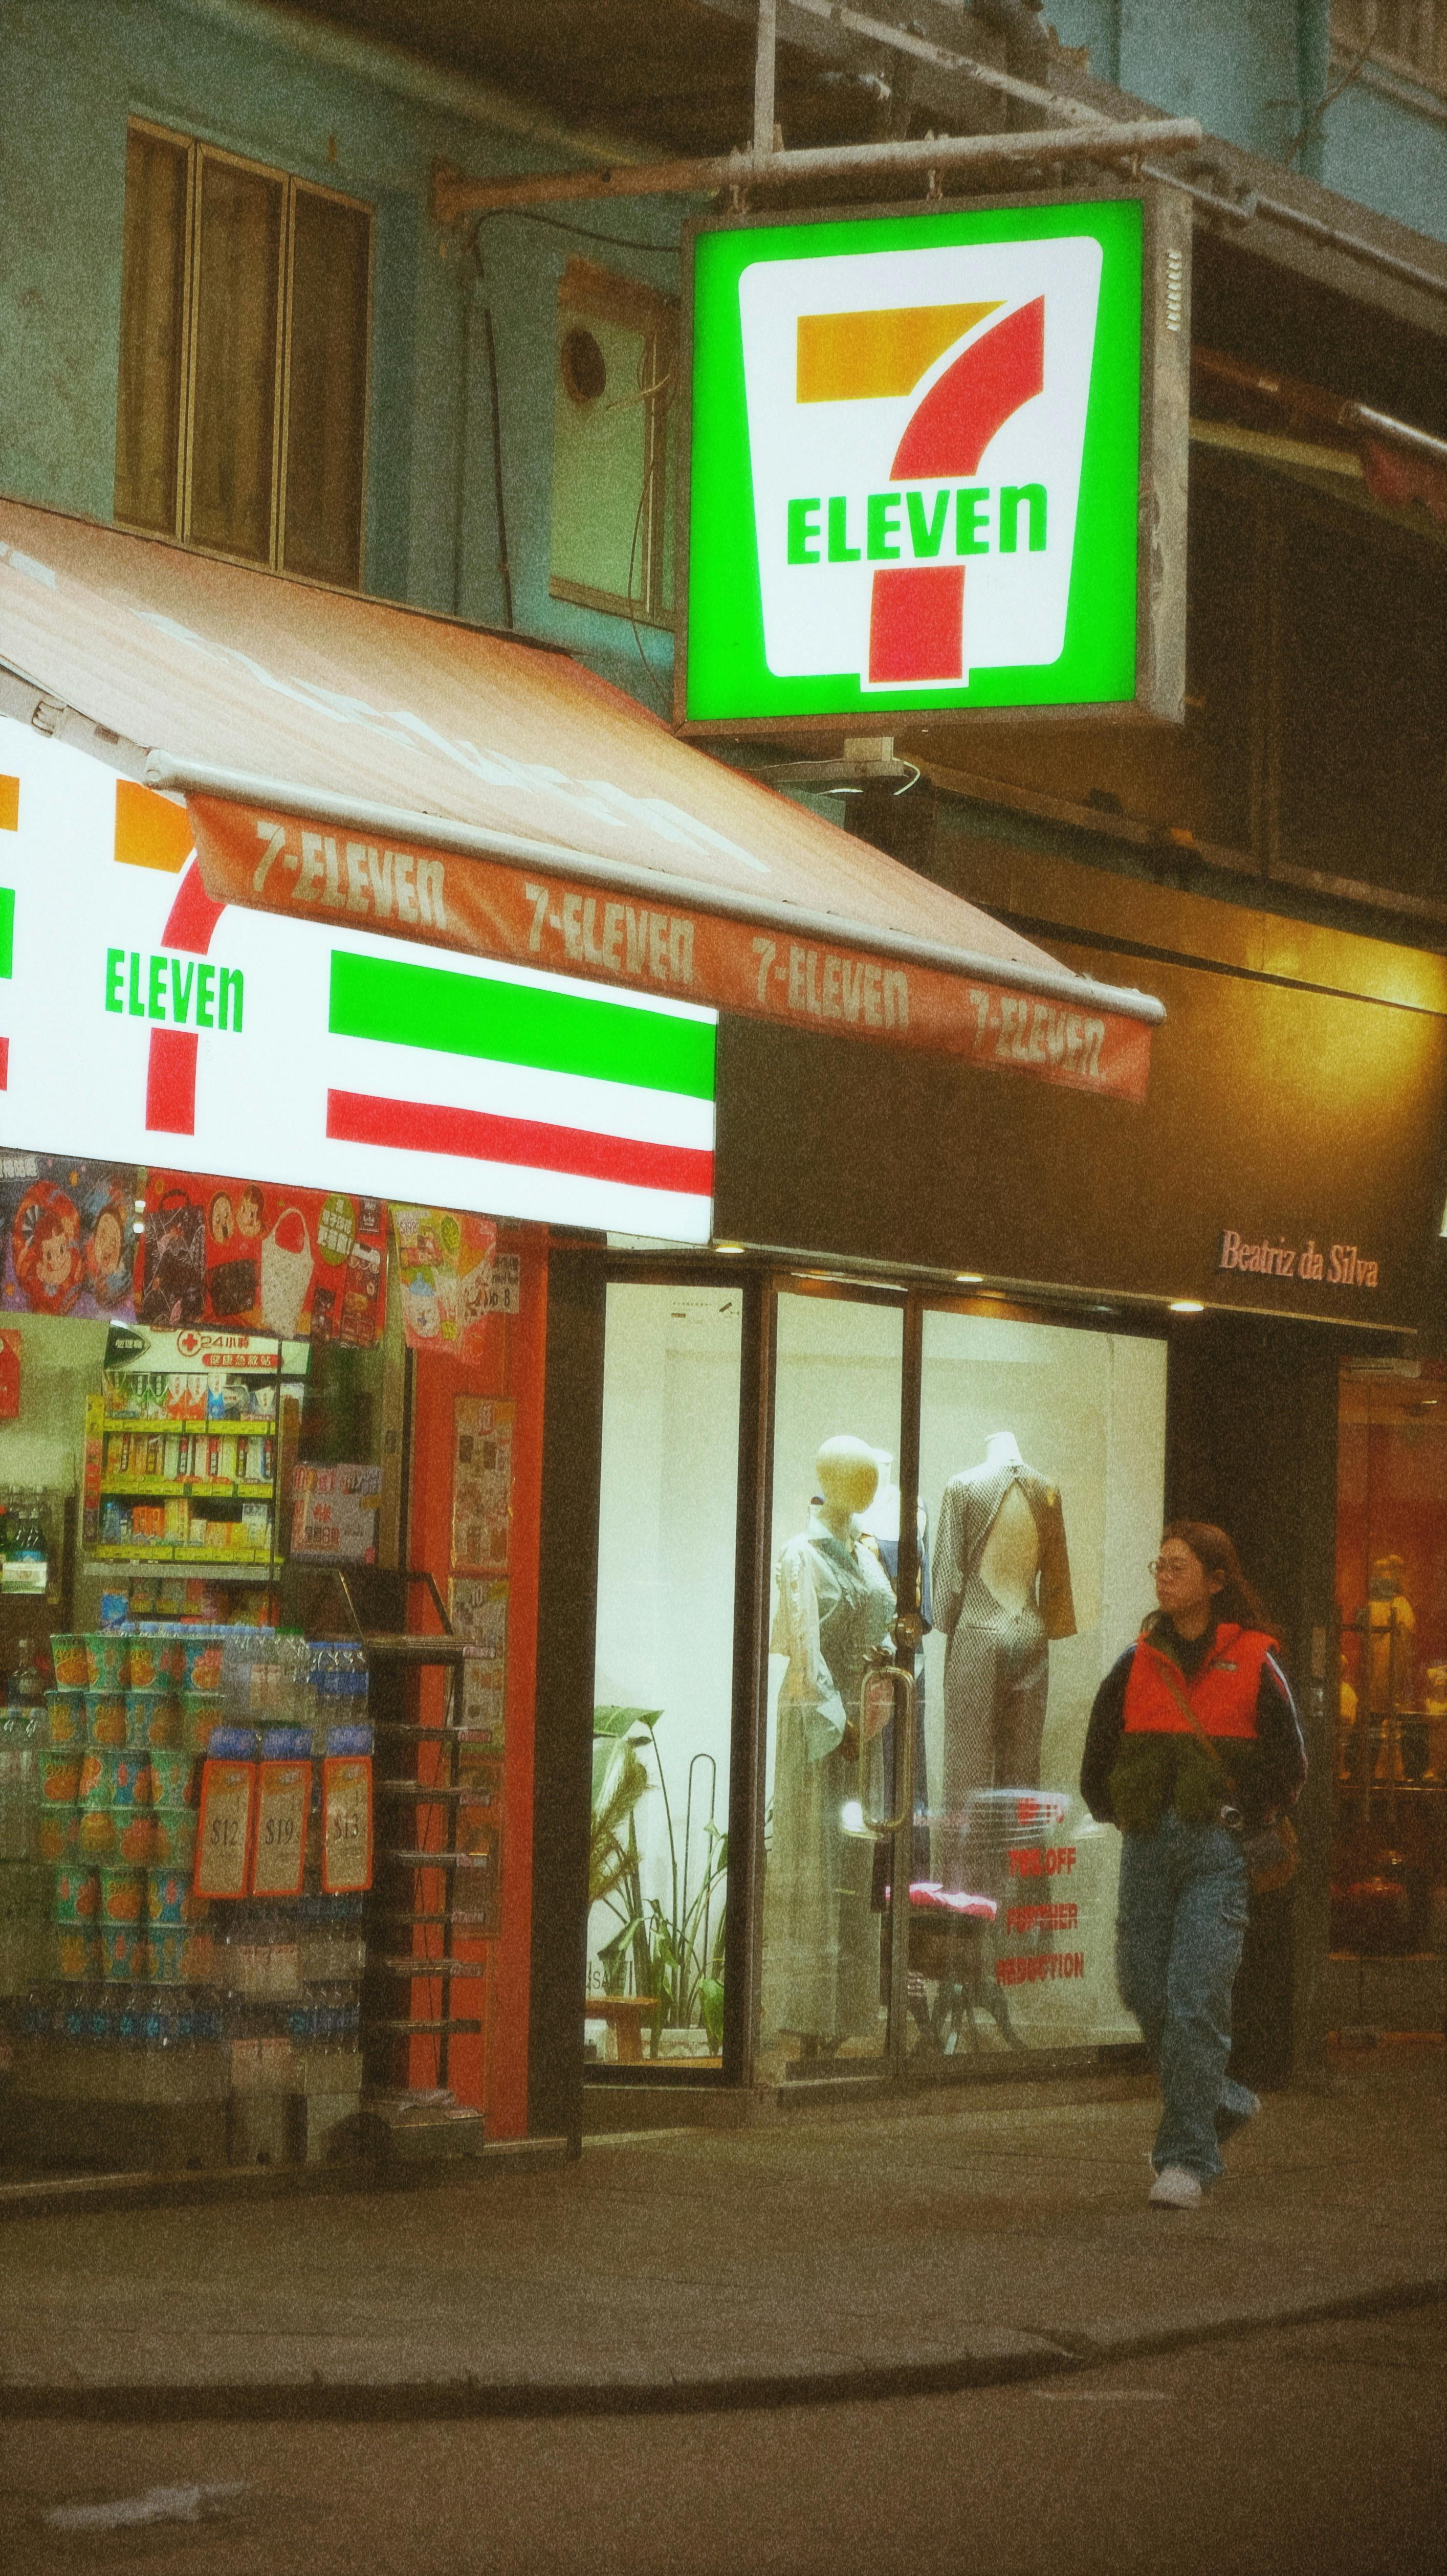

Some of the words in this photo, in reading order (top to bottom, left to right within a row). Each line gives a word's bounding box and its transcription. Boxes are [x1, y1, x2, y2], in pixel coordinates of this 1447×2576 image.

[1219, 1230, 1296, 1277] Beatriz
[1300, 1241, 1325, 1281] da
[1328, 1245, 1378, 1287] Silva
[209, 1356, 271, 1366] 健康急救站
[1045, 1847, 1076, 1875] OFF
[1007, 1903, 1078, 1935] FURTHER
[995, 1952, 1084, 1986] REDUCTION
